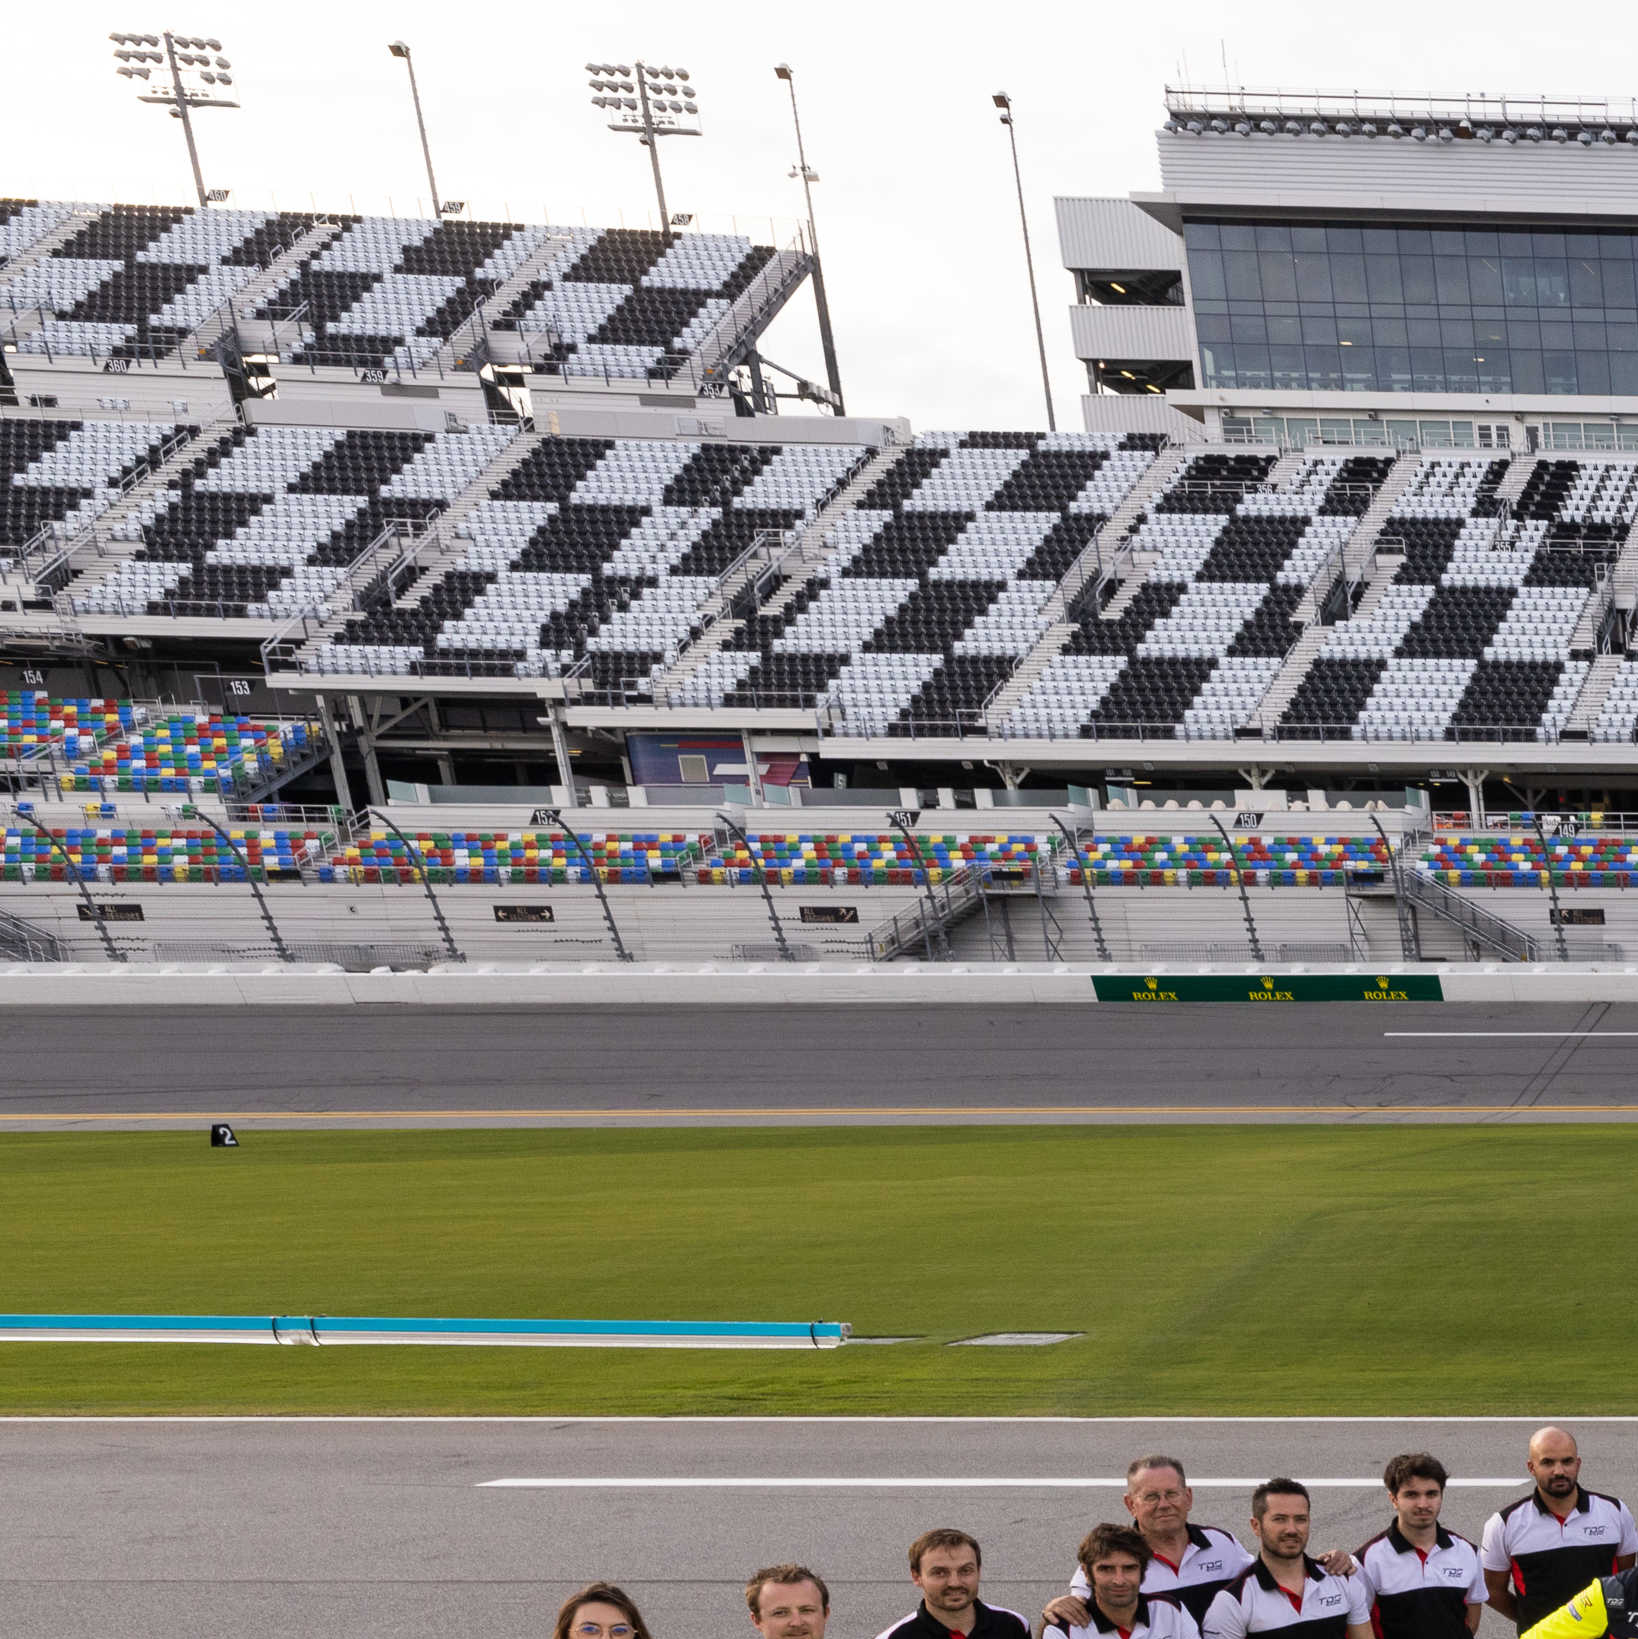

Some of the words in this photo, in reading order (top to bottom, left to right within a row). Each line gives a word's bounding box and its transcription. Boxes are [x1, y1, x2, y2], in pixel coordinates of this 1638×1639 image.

[108, 360, 127, 371] 360
[365, 370, 384, 382] 359
[1256, 484, 1273, 495] 356
[1495, 541, 1511, 552] 355
[22, 670, 43, 685] 154
[230, 680, 251, 695] 153
[1239, 812, 1257, 827] 150
[1557, 824, 1575, 838] 149
[1132, 991, 1179, 1001] ROLEX
[1248, 991, 1295, 1001] ROLEX
[1364, 991, 1409, 1000] ROLEX
[219, 1126, 237, 1145] 2
